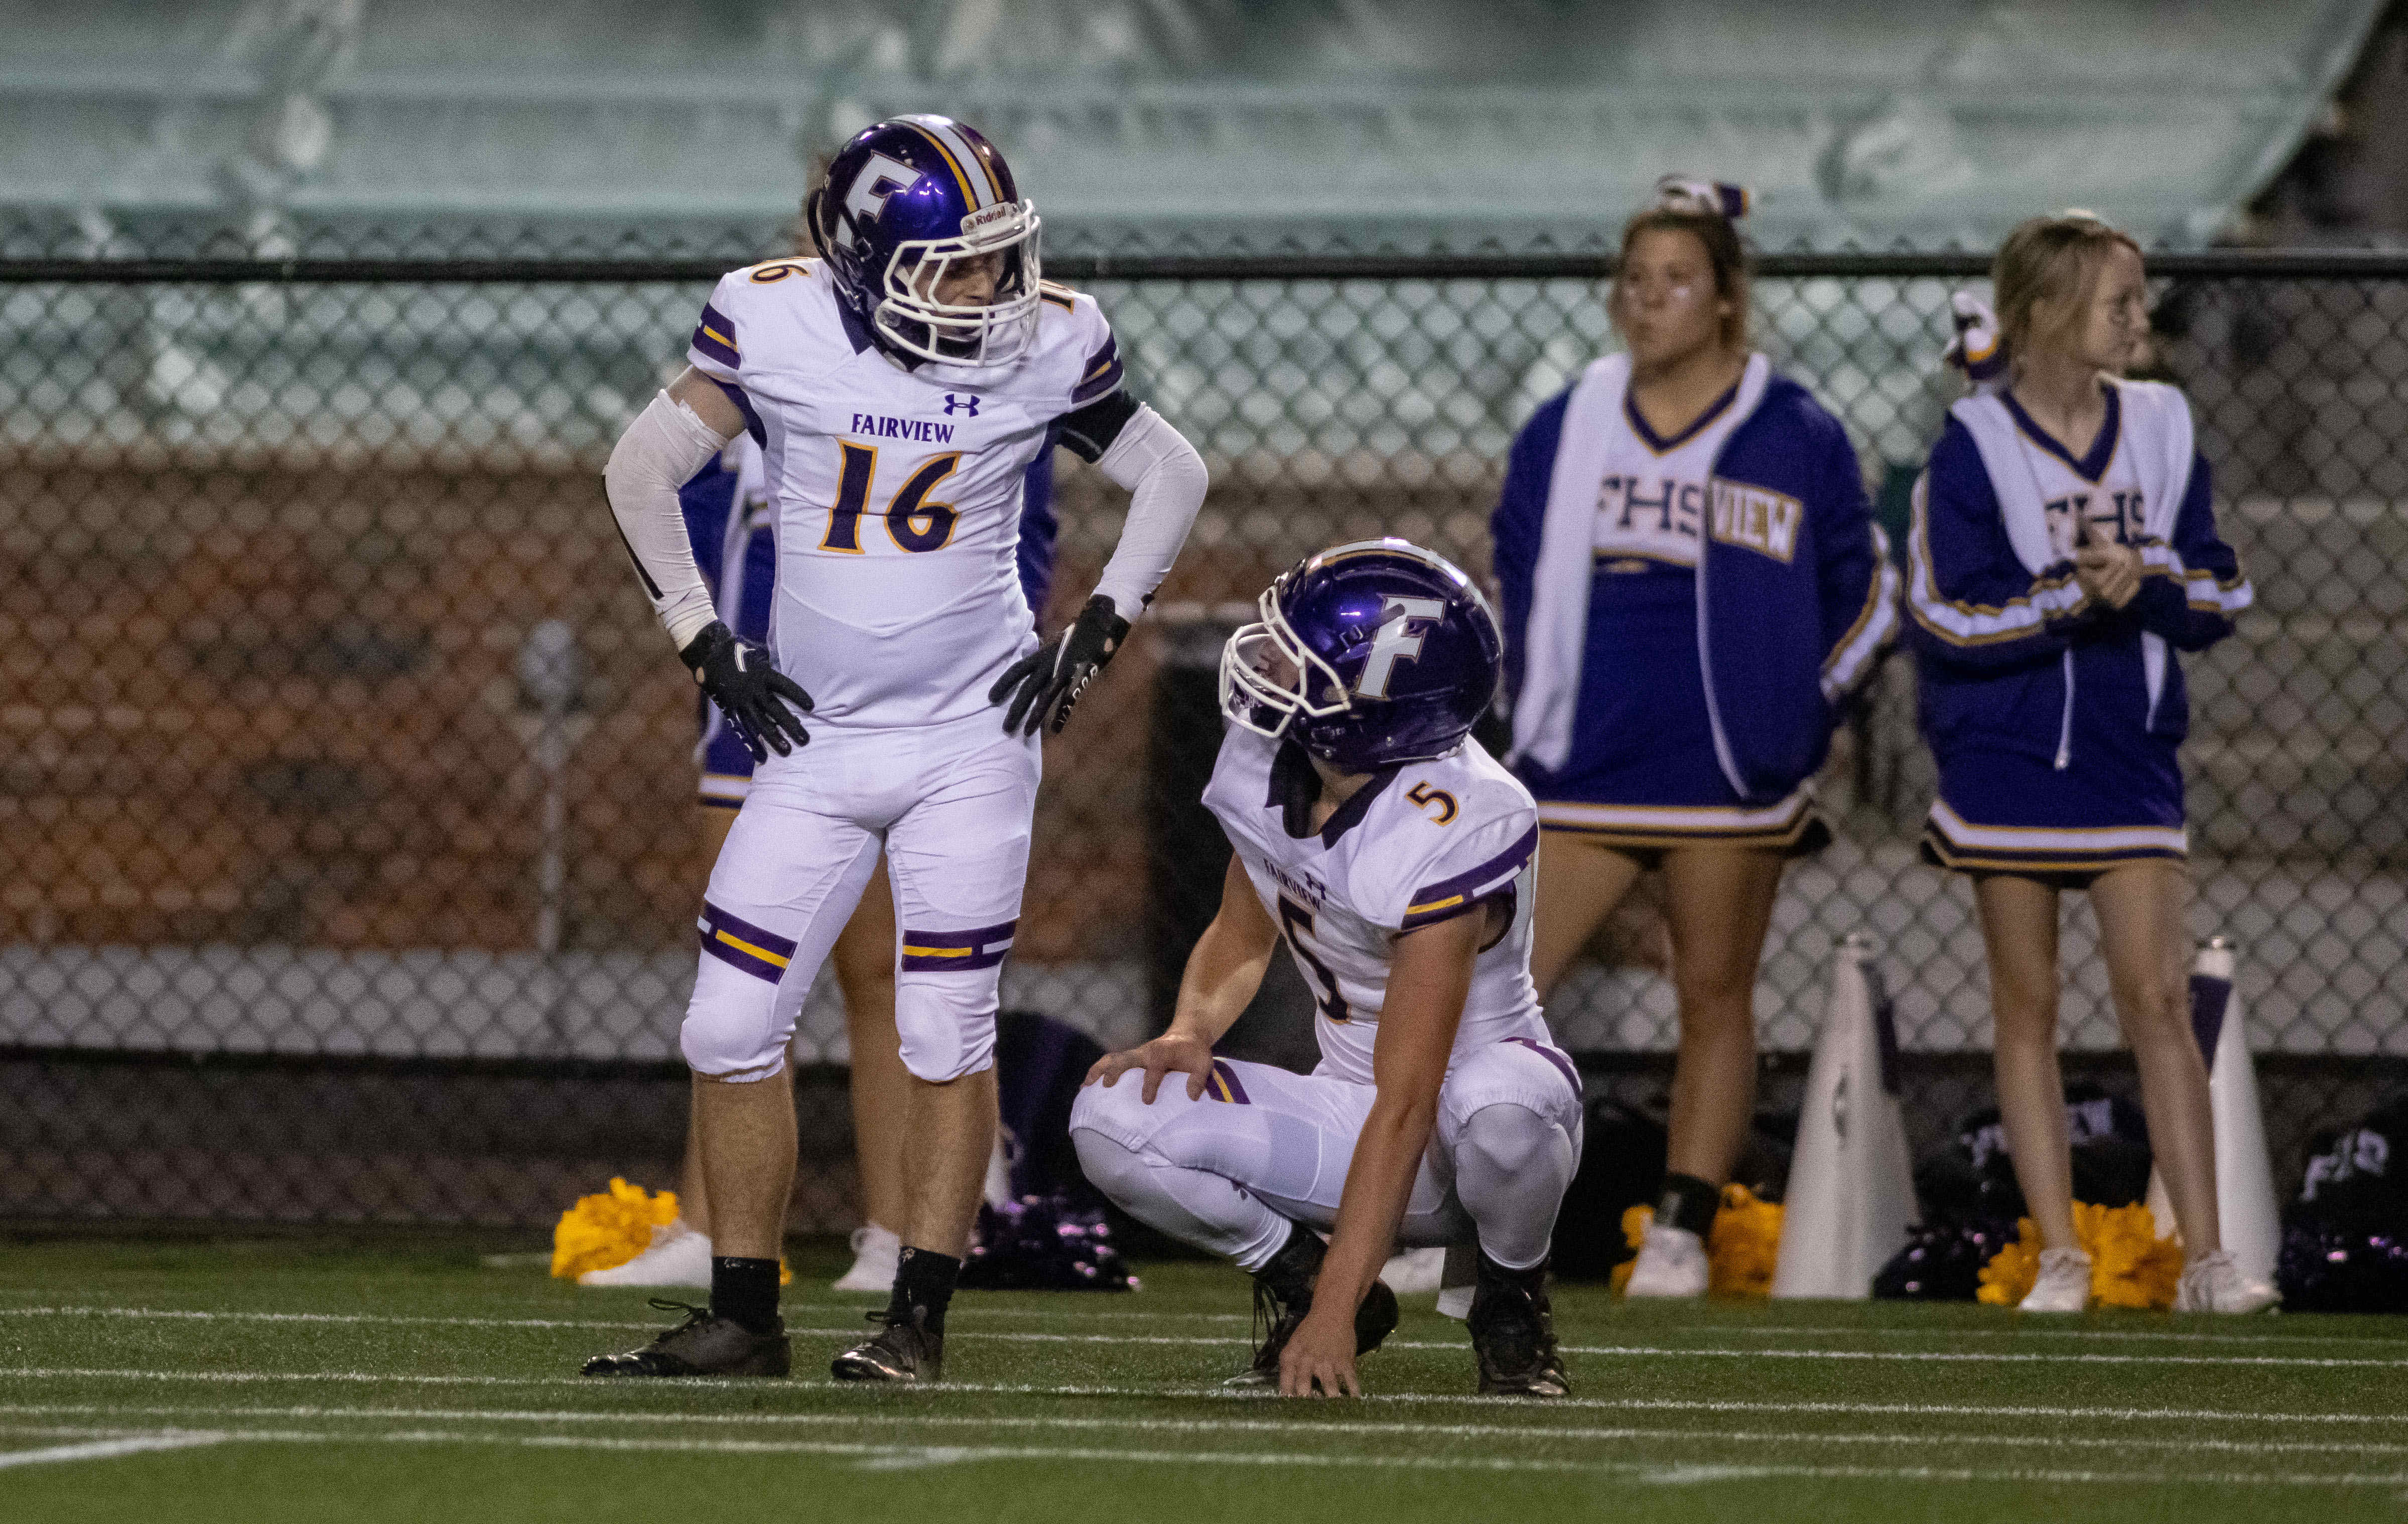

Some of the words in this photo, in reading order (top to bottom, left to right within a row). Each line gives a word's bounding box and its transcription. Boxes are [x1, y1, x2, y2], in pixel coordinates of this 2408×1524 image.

[749, 256, 812, 284] 6
[851, 413, 955, 444] FAIRVIEW
[817, 438, 962, 555] 16
[1356, 592, 1446, 702] F
[1404, 779, 1459, 827] 5
[1277, 892, 1350, 1026] 5
